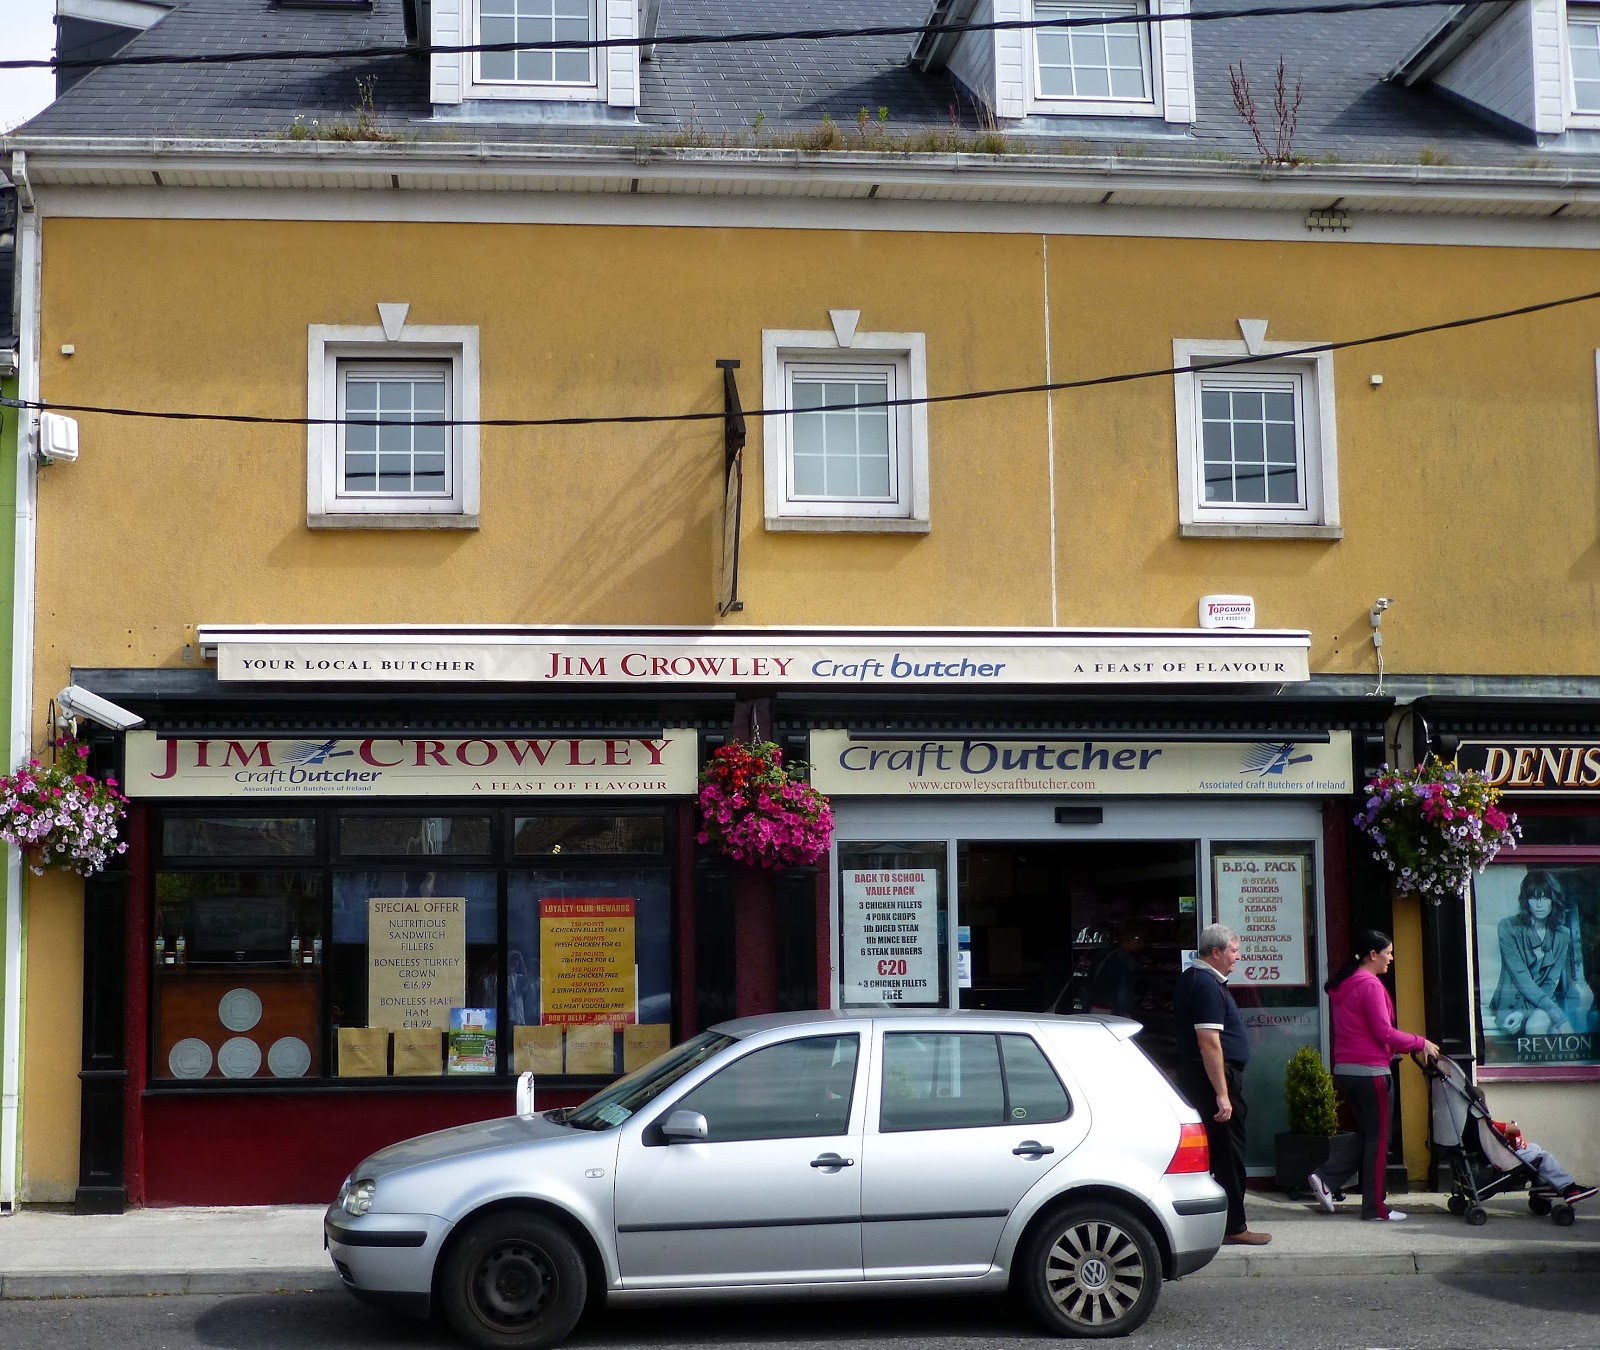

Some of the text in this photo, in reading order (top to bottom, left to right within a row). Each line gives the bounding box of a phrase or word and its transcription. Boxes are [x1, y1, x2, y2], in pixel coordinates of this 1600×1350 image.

[243, 659, 476, 672] YOUR LOCAL BUTCHER
[545, 652, 795, 679] JIM CROWLEY
[811, 653, 1006, 681] Craft butcher
[1073, 662, 1286, 673] A FEAST OF FLAVOUR
[150, 739, 674, 779] JIM CROWLEY
[839, 742, 953, 776] Craft
[1485, 747, 1600, 787] DENIS
[234, 768, 288, 784] Craft
[471, 780, 667, 791] A FEAST OF FLAVOUR
[908, 778, 1095, 793] www.crowleyscraftbutcher.com
[1199, 780, 1345, 790] Associated Craft Butchers of Ireland
[1222, 861, 1297, 873] B.B.Q. PACK
[854, 873, 925, 883] BACK TO SCHOOL
[865, 886, 915, 896] VAULE PACK
[374, 902, 460, 913] SPECIAL OFFER
[544, 903, 630, 913] LOYALTY CLUB REWARDS
[858, 901, 923, 910] 3 CHICKEN FILLETS
[865, 912, 916, 921] 4 PORK CHOPS
[388, 919, 446, 928] NUTRITIOUS
[875, 924, 896, 933] DICED
[897, 924, 919, 932] STEAK
[388, 931, 446, 940] SANDWITCH
[877, 936, 900, 944] MINCE
[901, 936, 918, 944] BEEF
[401, 942, 434, 951] FILLERS
[860, 947, 923, 956] 6 STEAK BURGERS
[374, 958, 460, 967] BONELESS TURKEY
[877, 959, 907, 976] €20
[398, 969, 436, 978] CROWN
[1244, 966, 1281, 980] €25
[403, 981, 432, 990] €16.99
[863, 980, 869, 988] 3
[870, 980, 901, 988] CHICKEN
[902, 979, 927, 988] FILLETS
[882, 989, 903, 1000] FREE
[380, 997, 454, 1006] BONELESS HALF
[405, 1008, 429, 1017] HAM
[403, 1020, 432, 1028] €14.99
[1257, 1014, 1312, 1024] CROWLEY
[1517, 1035, 1592, 1053] REVLON
